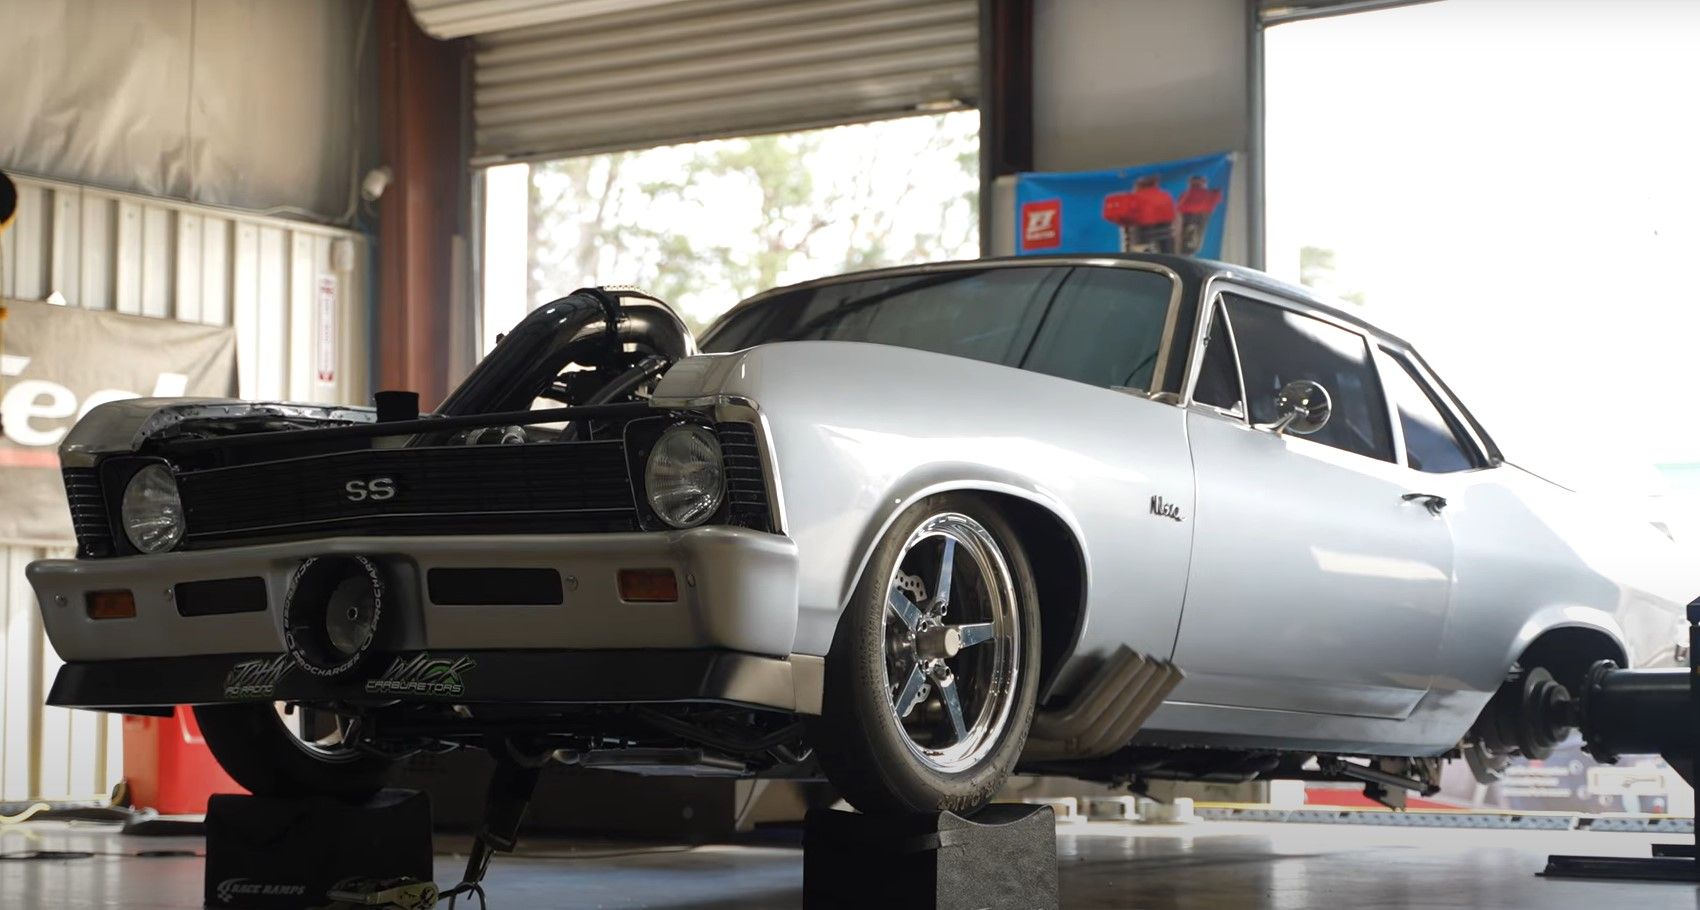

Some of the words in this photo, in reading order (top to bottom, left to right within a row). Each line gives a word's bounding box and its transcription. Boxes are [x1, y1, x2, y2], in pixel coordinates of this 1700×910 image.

[346, 478, 395, 501] SS
[292, 650, 361, 677] PROCHARGER
[366, 681, 462, 694] CARBURETORS
[262, 885, 306, 895] RAMPS
